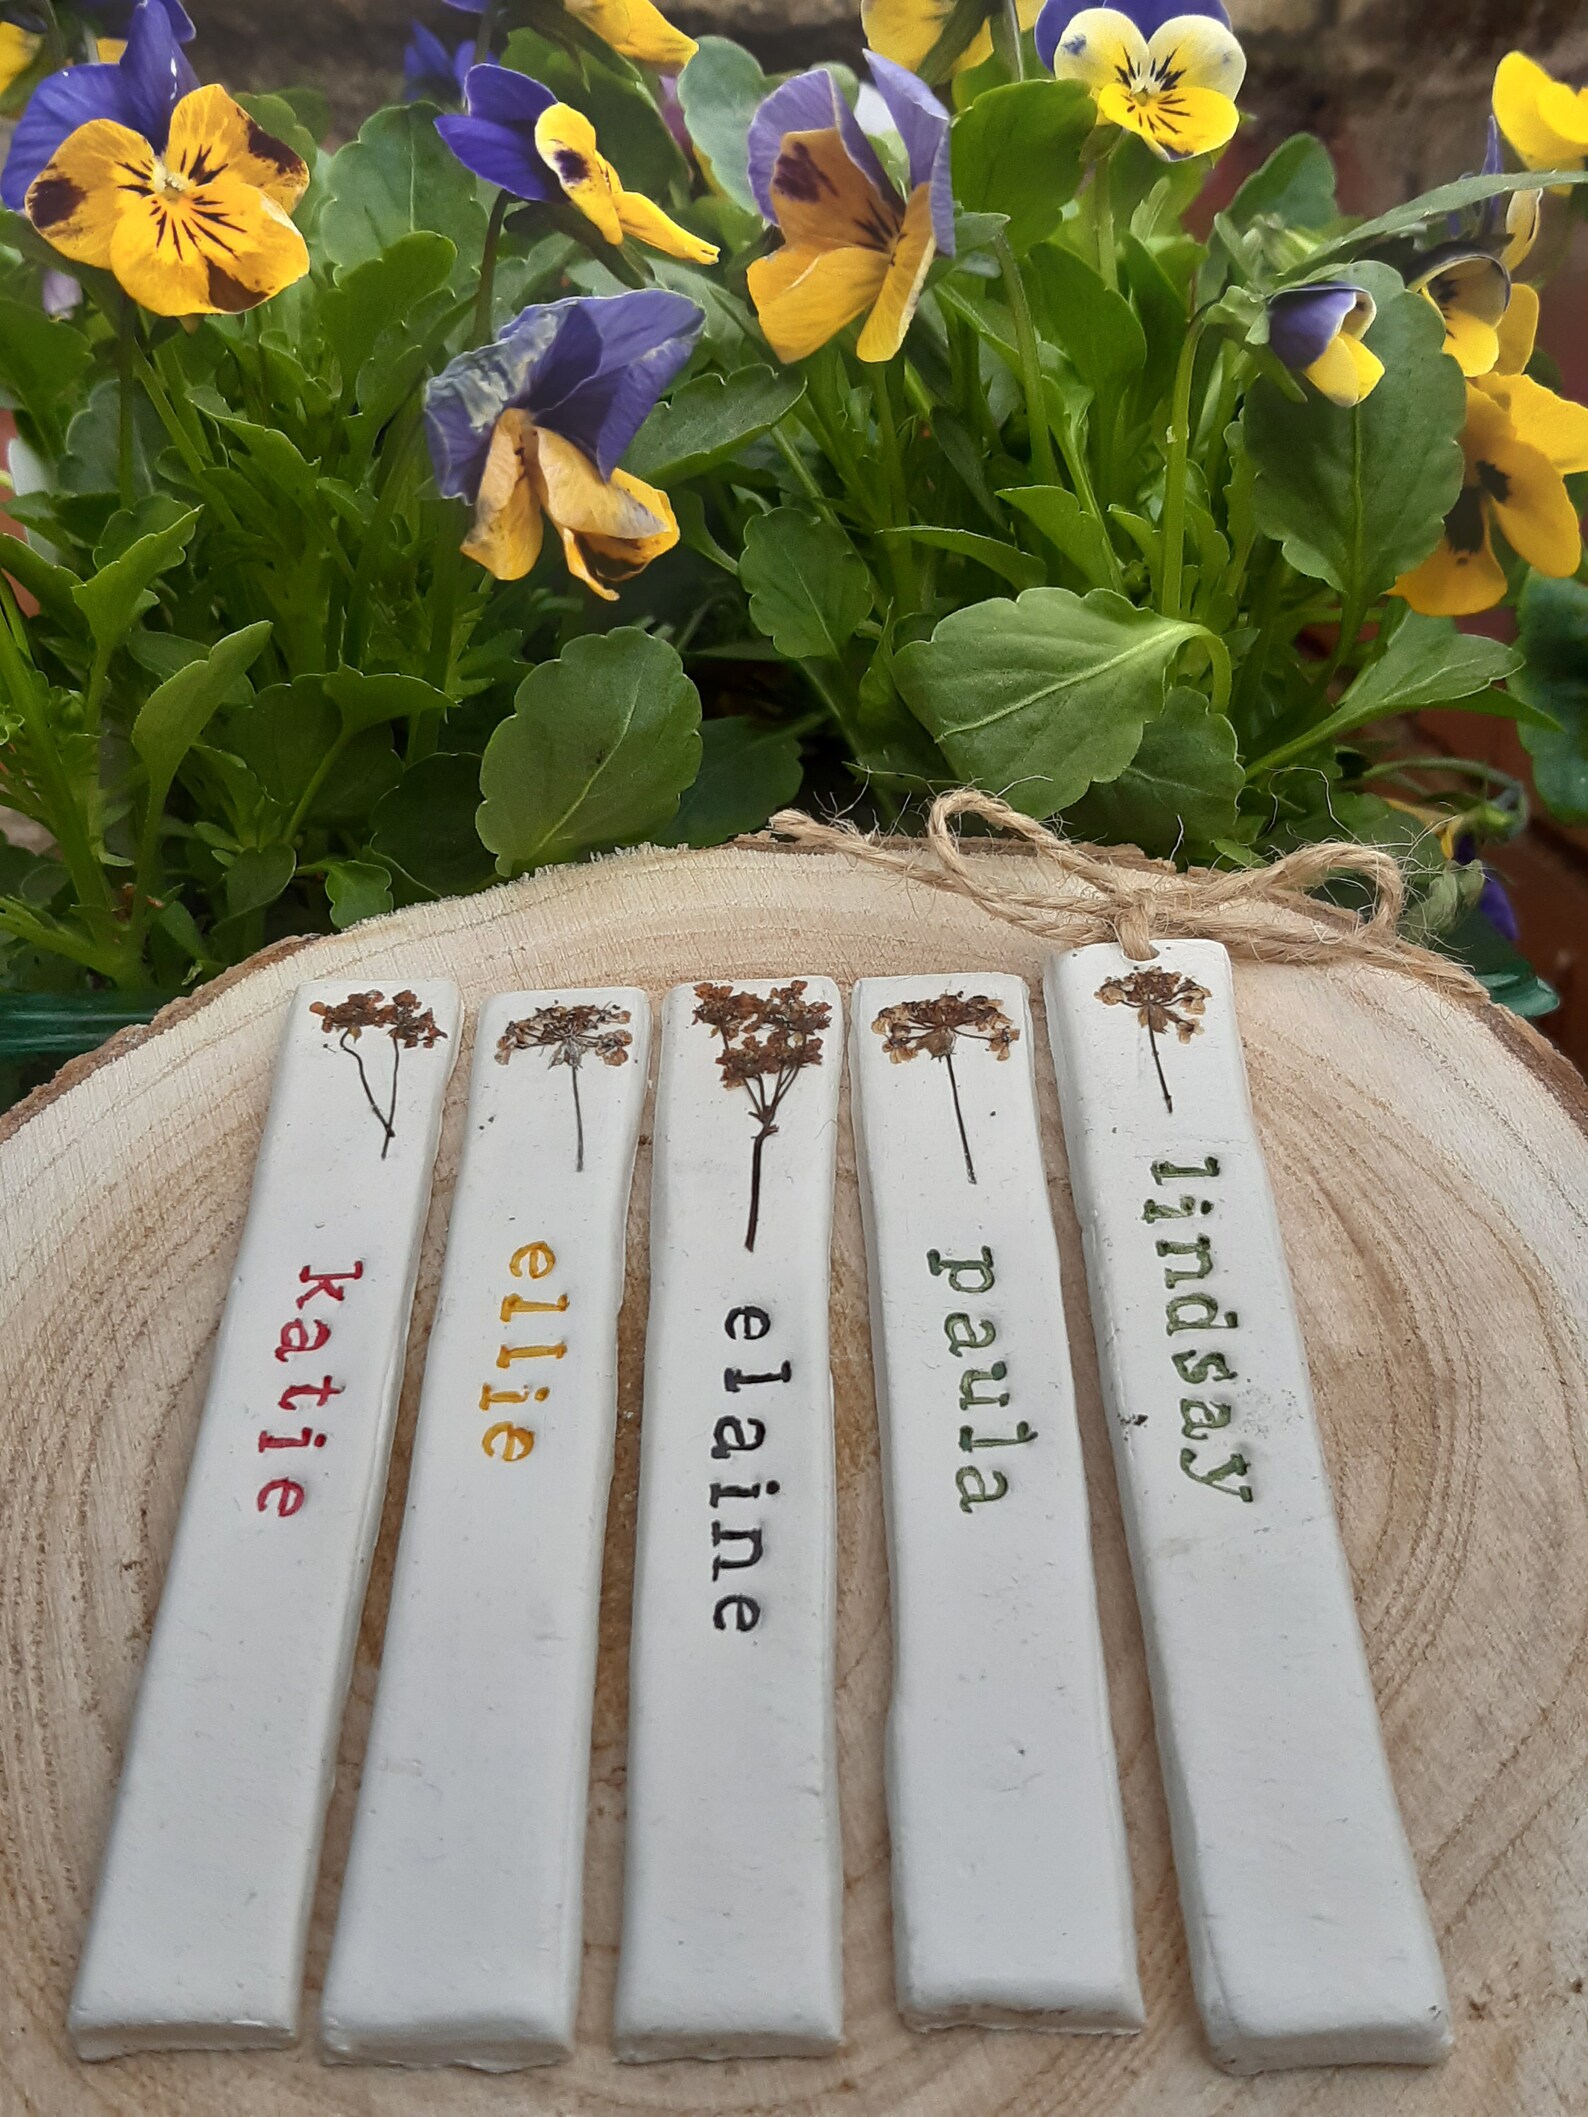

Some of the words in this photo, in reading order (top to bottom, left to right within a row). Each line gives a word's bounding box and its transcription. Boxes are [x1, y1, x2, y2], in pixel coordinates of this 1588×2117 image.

[256, 1258, 365, 1519] katie
[479, 1240, 570, 1463] ellie
[926, 1244, 1039, 1514] paula
[1143, 1155, 1255, 1505] lindsay
[708, 1303, 793, 1635] elaine
